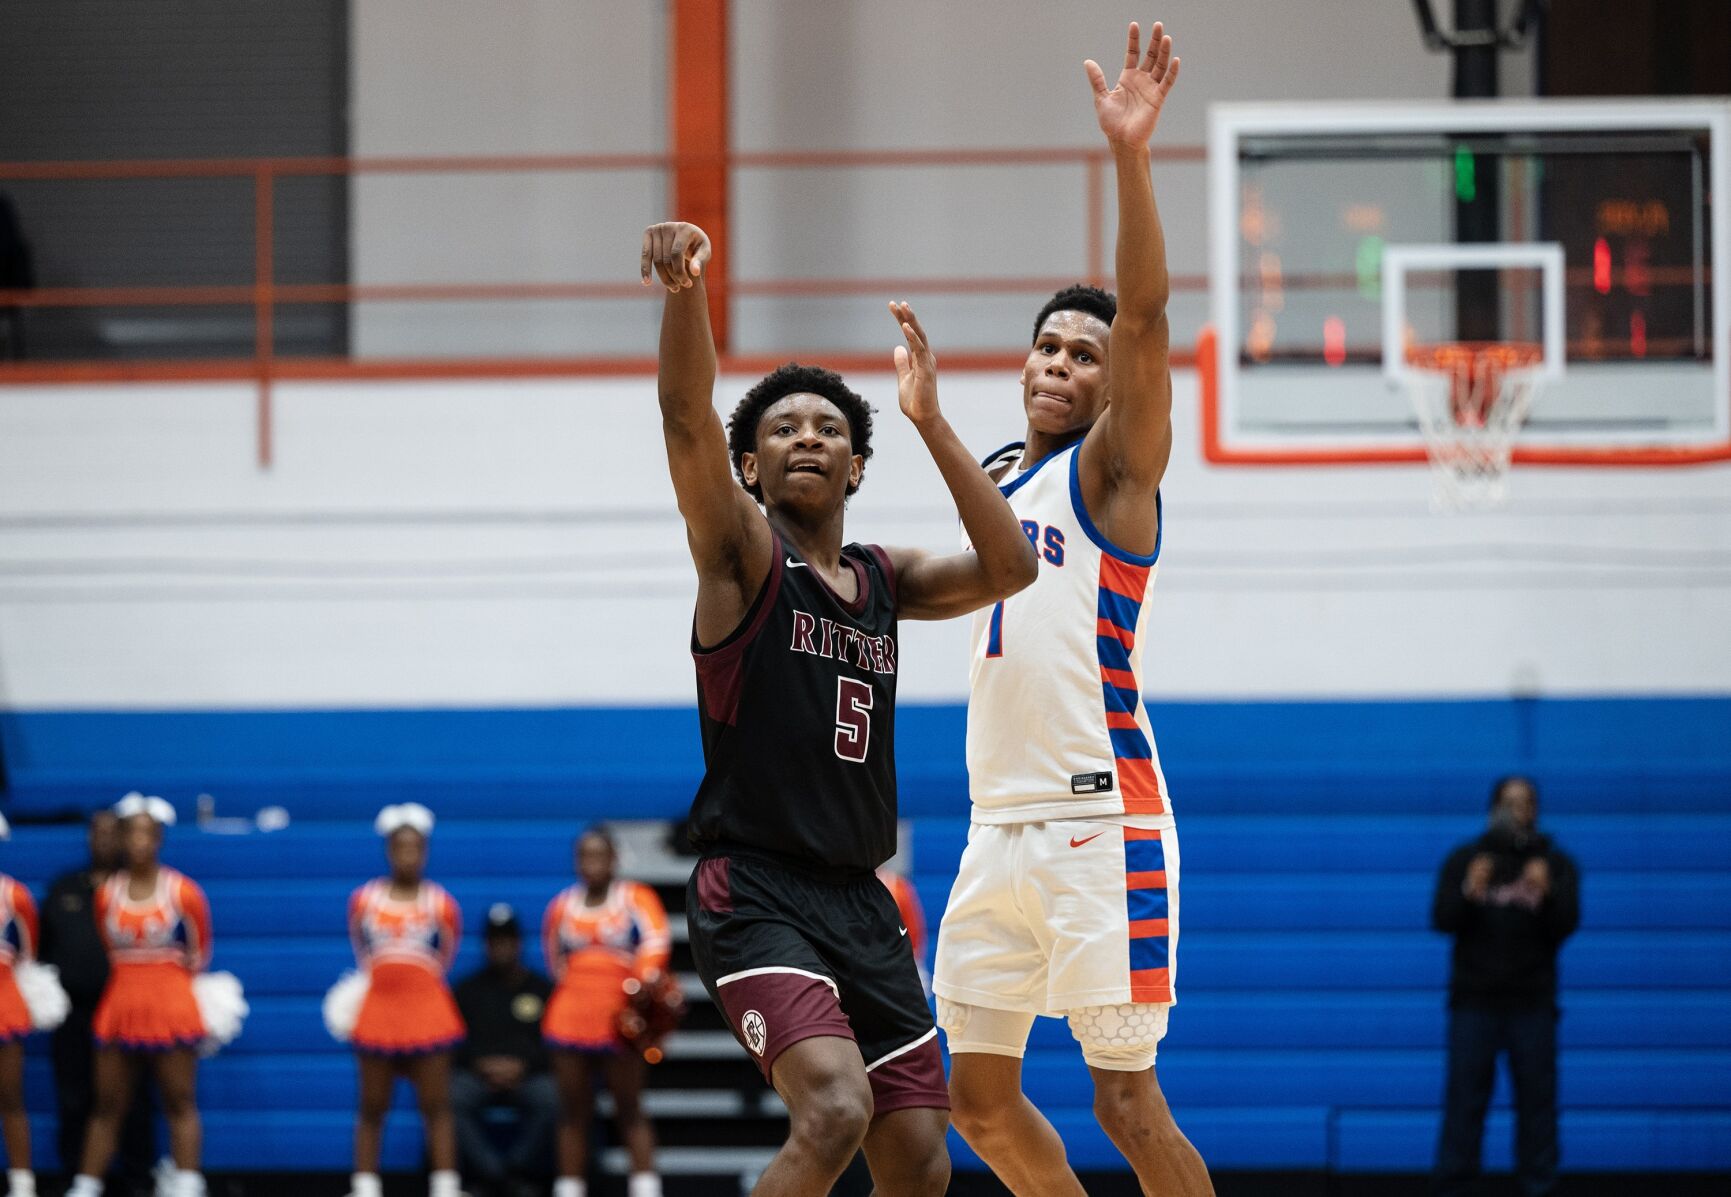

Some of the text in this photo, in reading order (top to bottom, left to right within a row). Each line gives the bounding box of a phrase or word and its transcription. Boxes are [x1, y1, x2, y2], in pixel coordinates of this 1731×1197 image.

[1020, 519, 1065, 568] RS
[790, 609, 896, 675] RITTER
[834, 675, 874, 763] 5
[1099, 777, 1107, 786] M
